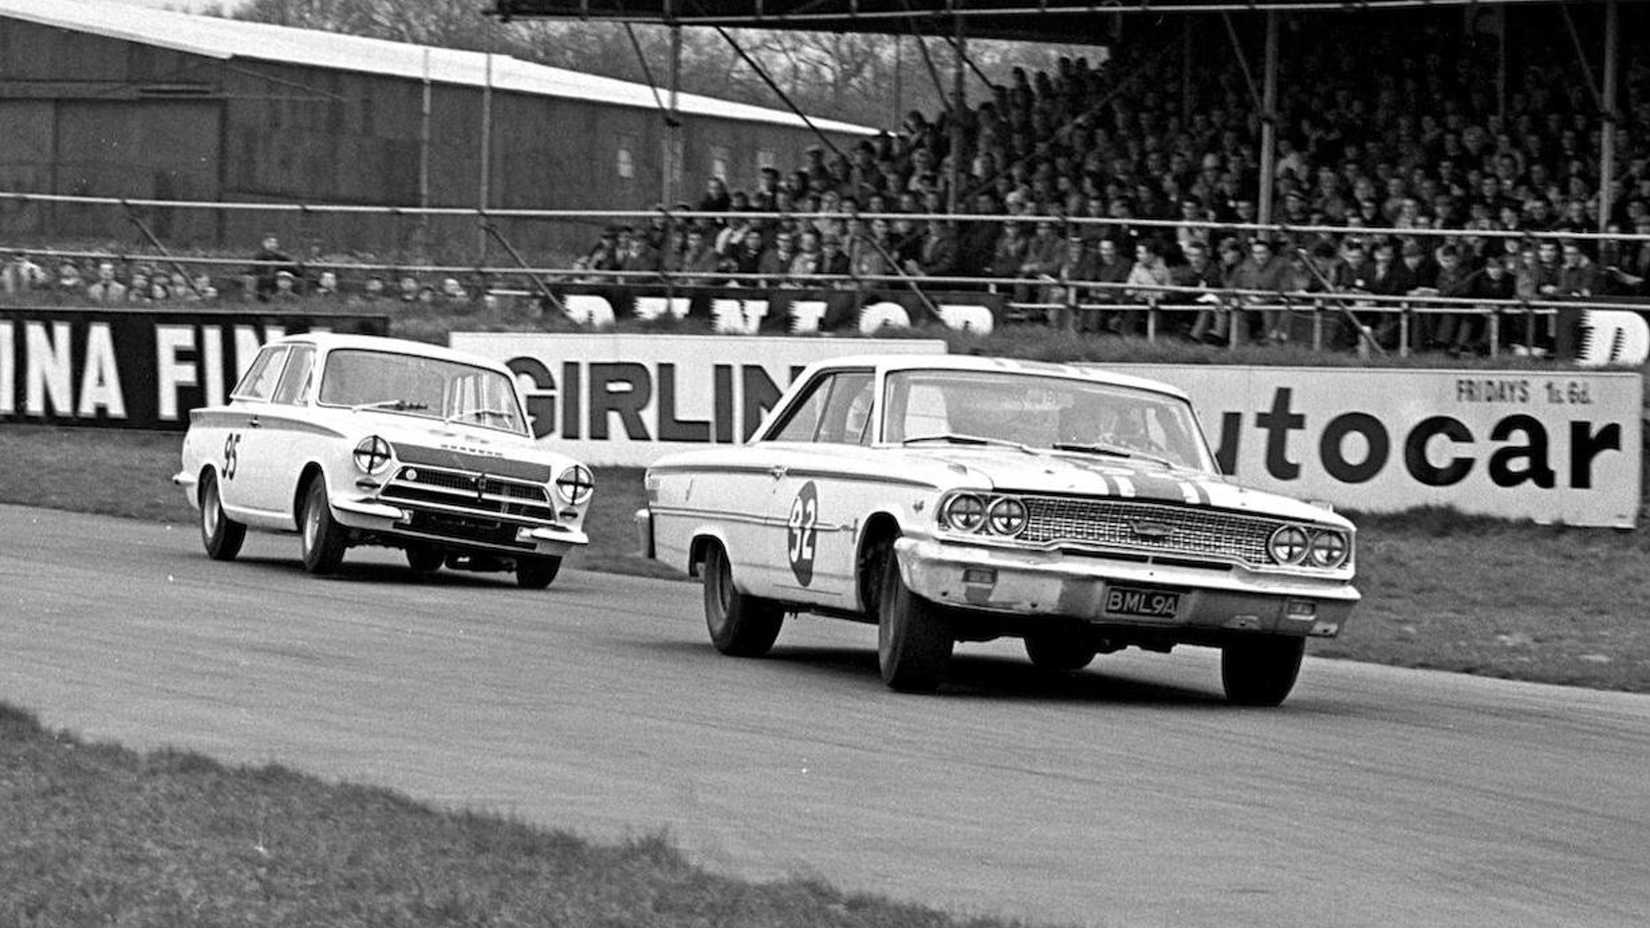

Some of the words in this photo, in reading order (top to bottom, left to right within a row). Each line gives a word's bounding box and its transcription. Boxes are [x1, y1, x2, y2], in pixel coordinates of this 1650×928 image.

[154, 323, 333, 420] FIN
[1456, 379, 1529, 403] FRIDAYS
[222, 433, 241, 481] 95
[790, 497, 815, 562] 92
